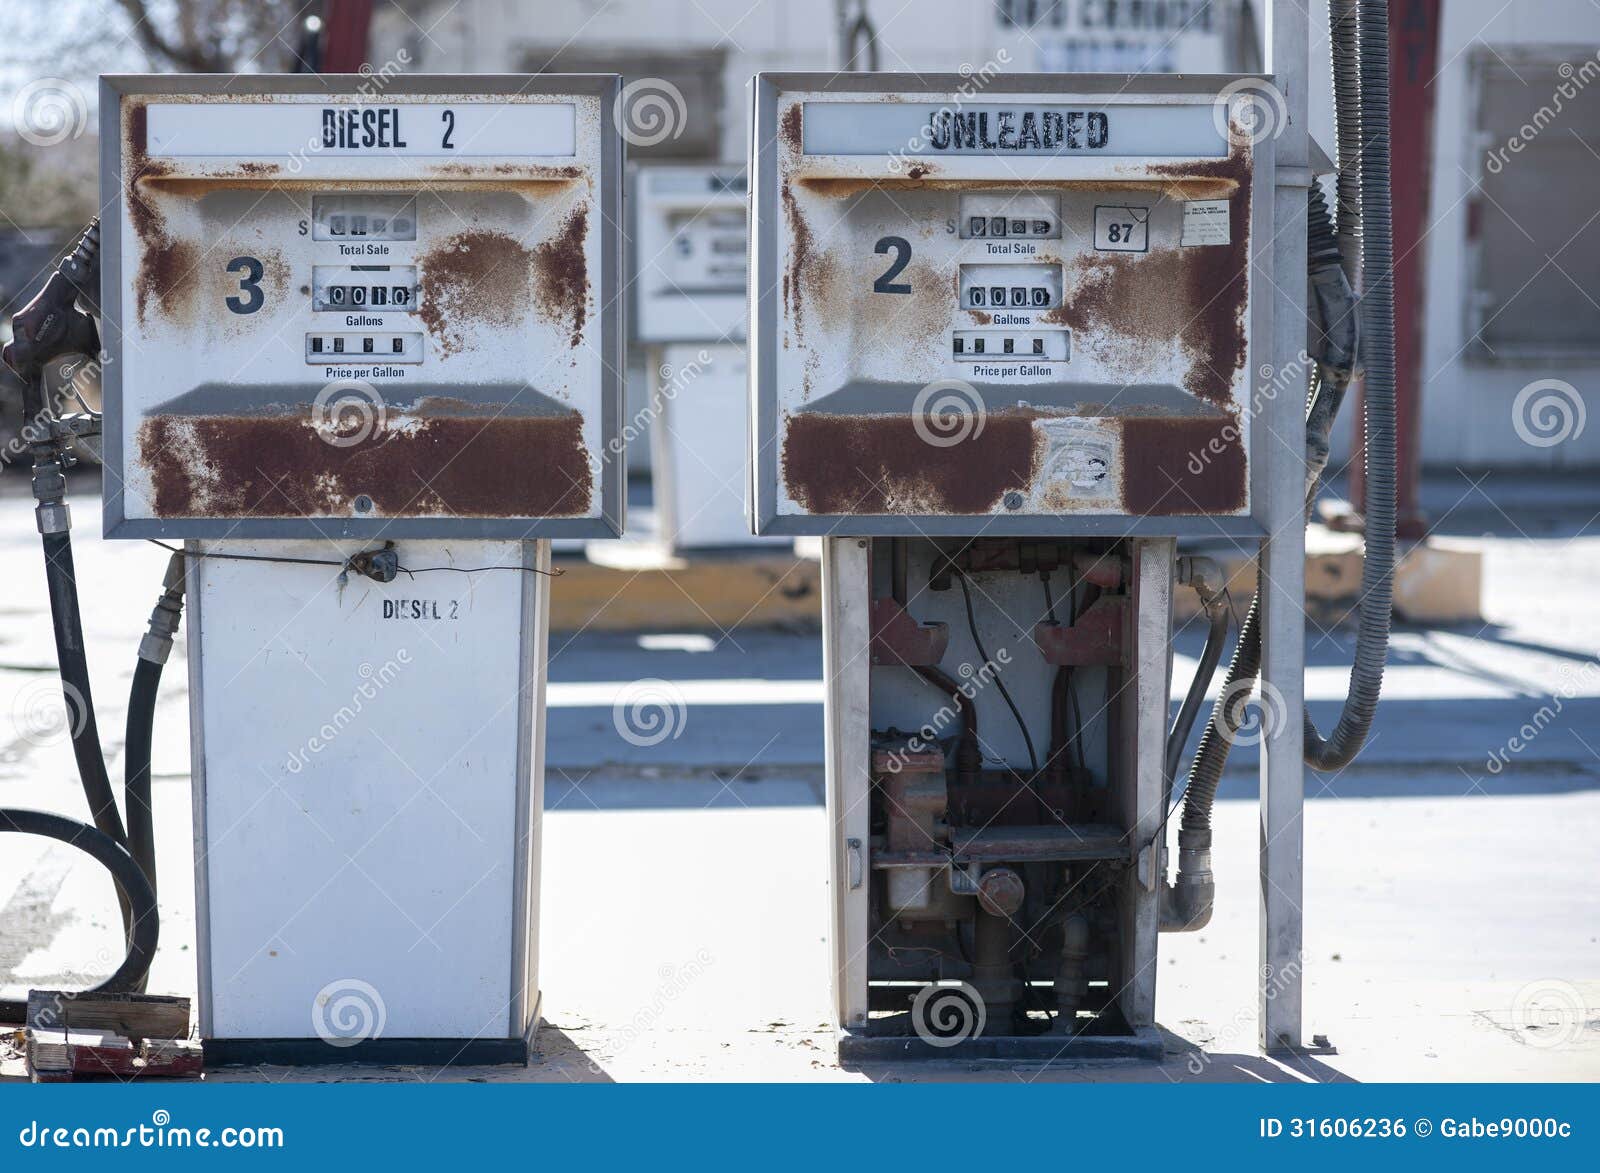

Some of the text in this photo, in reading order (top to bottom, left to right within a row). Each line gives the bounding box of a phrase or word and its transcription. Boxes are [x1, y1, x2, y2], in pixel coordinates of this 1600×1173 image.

[322, 108, 455, 149] DIESEL 2
[930, 112, 1109, 150] UNLEADED
[1108, 223, 1133, 243] 87
[339, 244, 390, 255] Total Sale
[986, 243, 1036, 254] Total Sale
[873, 236, 912, 294] 2
[226, 256, 264, 314] 3
[346, 315, 383, 326] Gallons
[993, 314, 1030, 325] Gallons
[326, 367, 405, 379] Price per Gallon
[974, 366, 1052, 378] Price per Gallon
[383, 600, 459, 619] DIESEL 2
